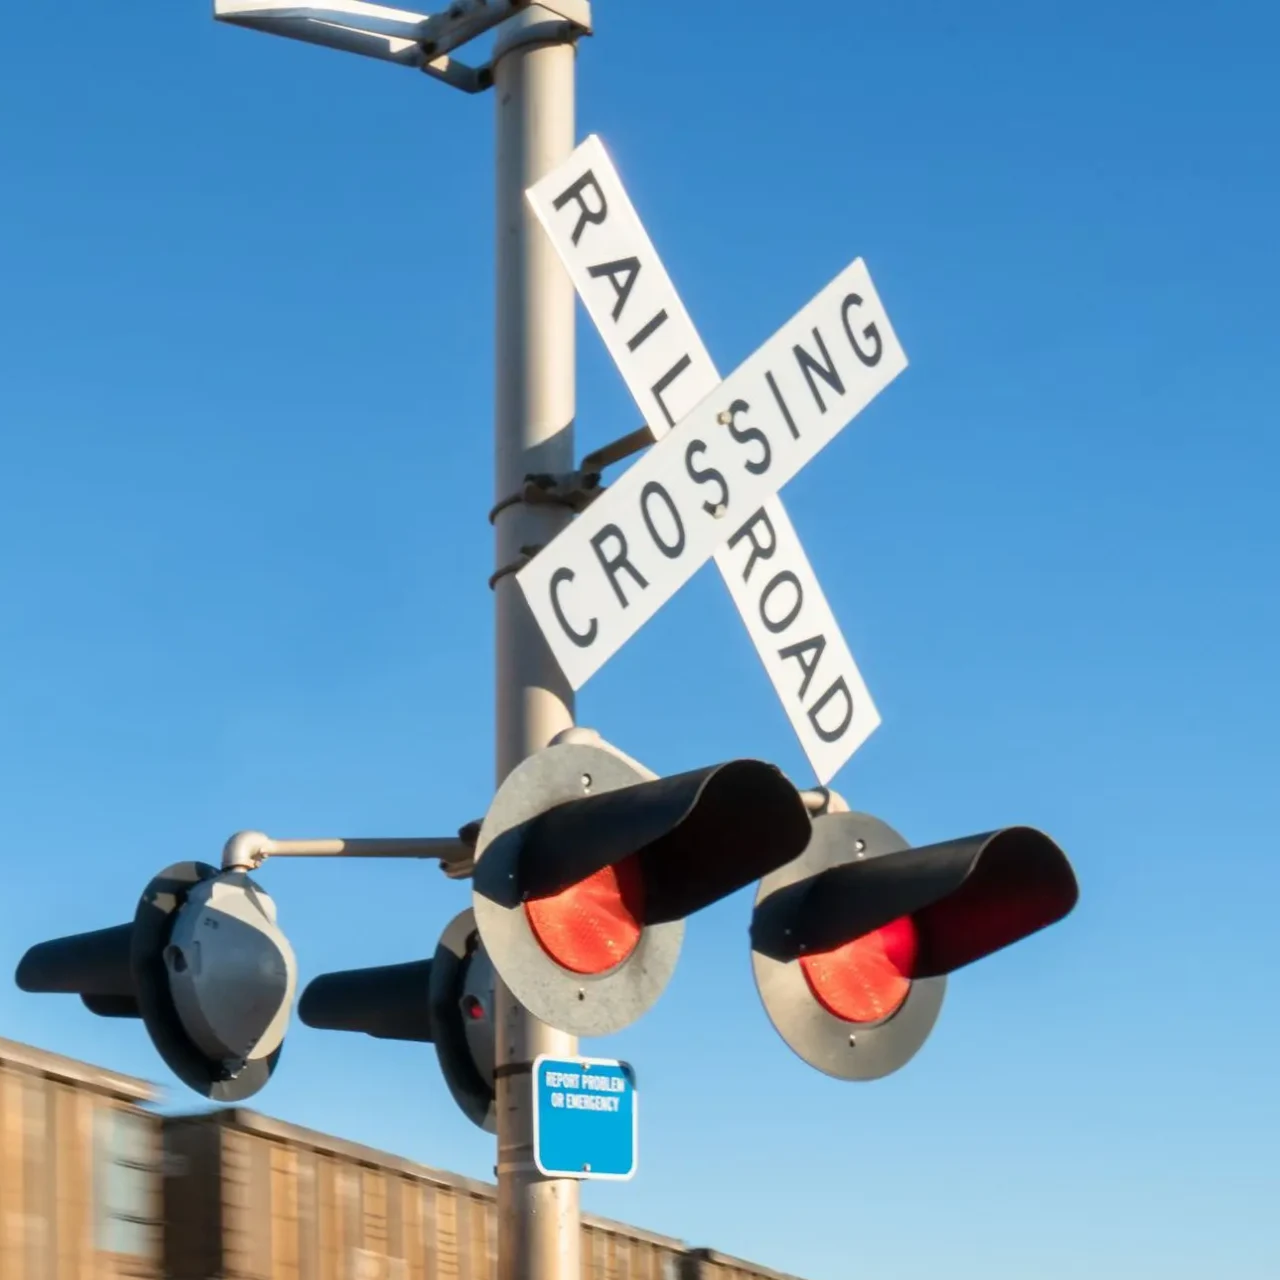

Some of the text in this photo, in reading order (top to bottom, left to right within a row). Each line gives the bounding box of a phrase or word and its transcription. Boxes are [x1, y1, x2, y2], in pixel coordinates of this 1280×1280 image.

[550, 293, 882, 648] CROSSING
[553, 170, 853, 743] RAIL ROAD
[545, 1071, 625, 1093] REPORT PROBLEM
[551, 1092, 619, 1112] OR EMERGENCY
